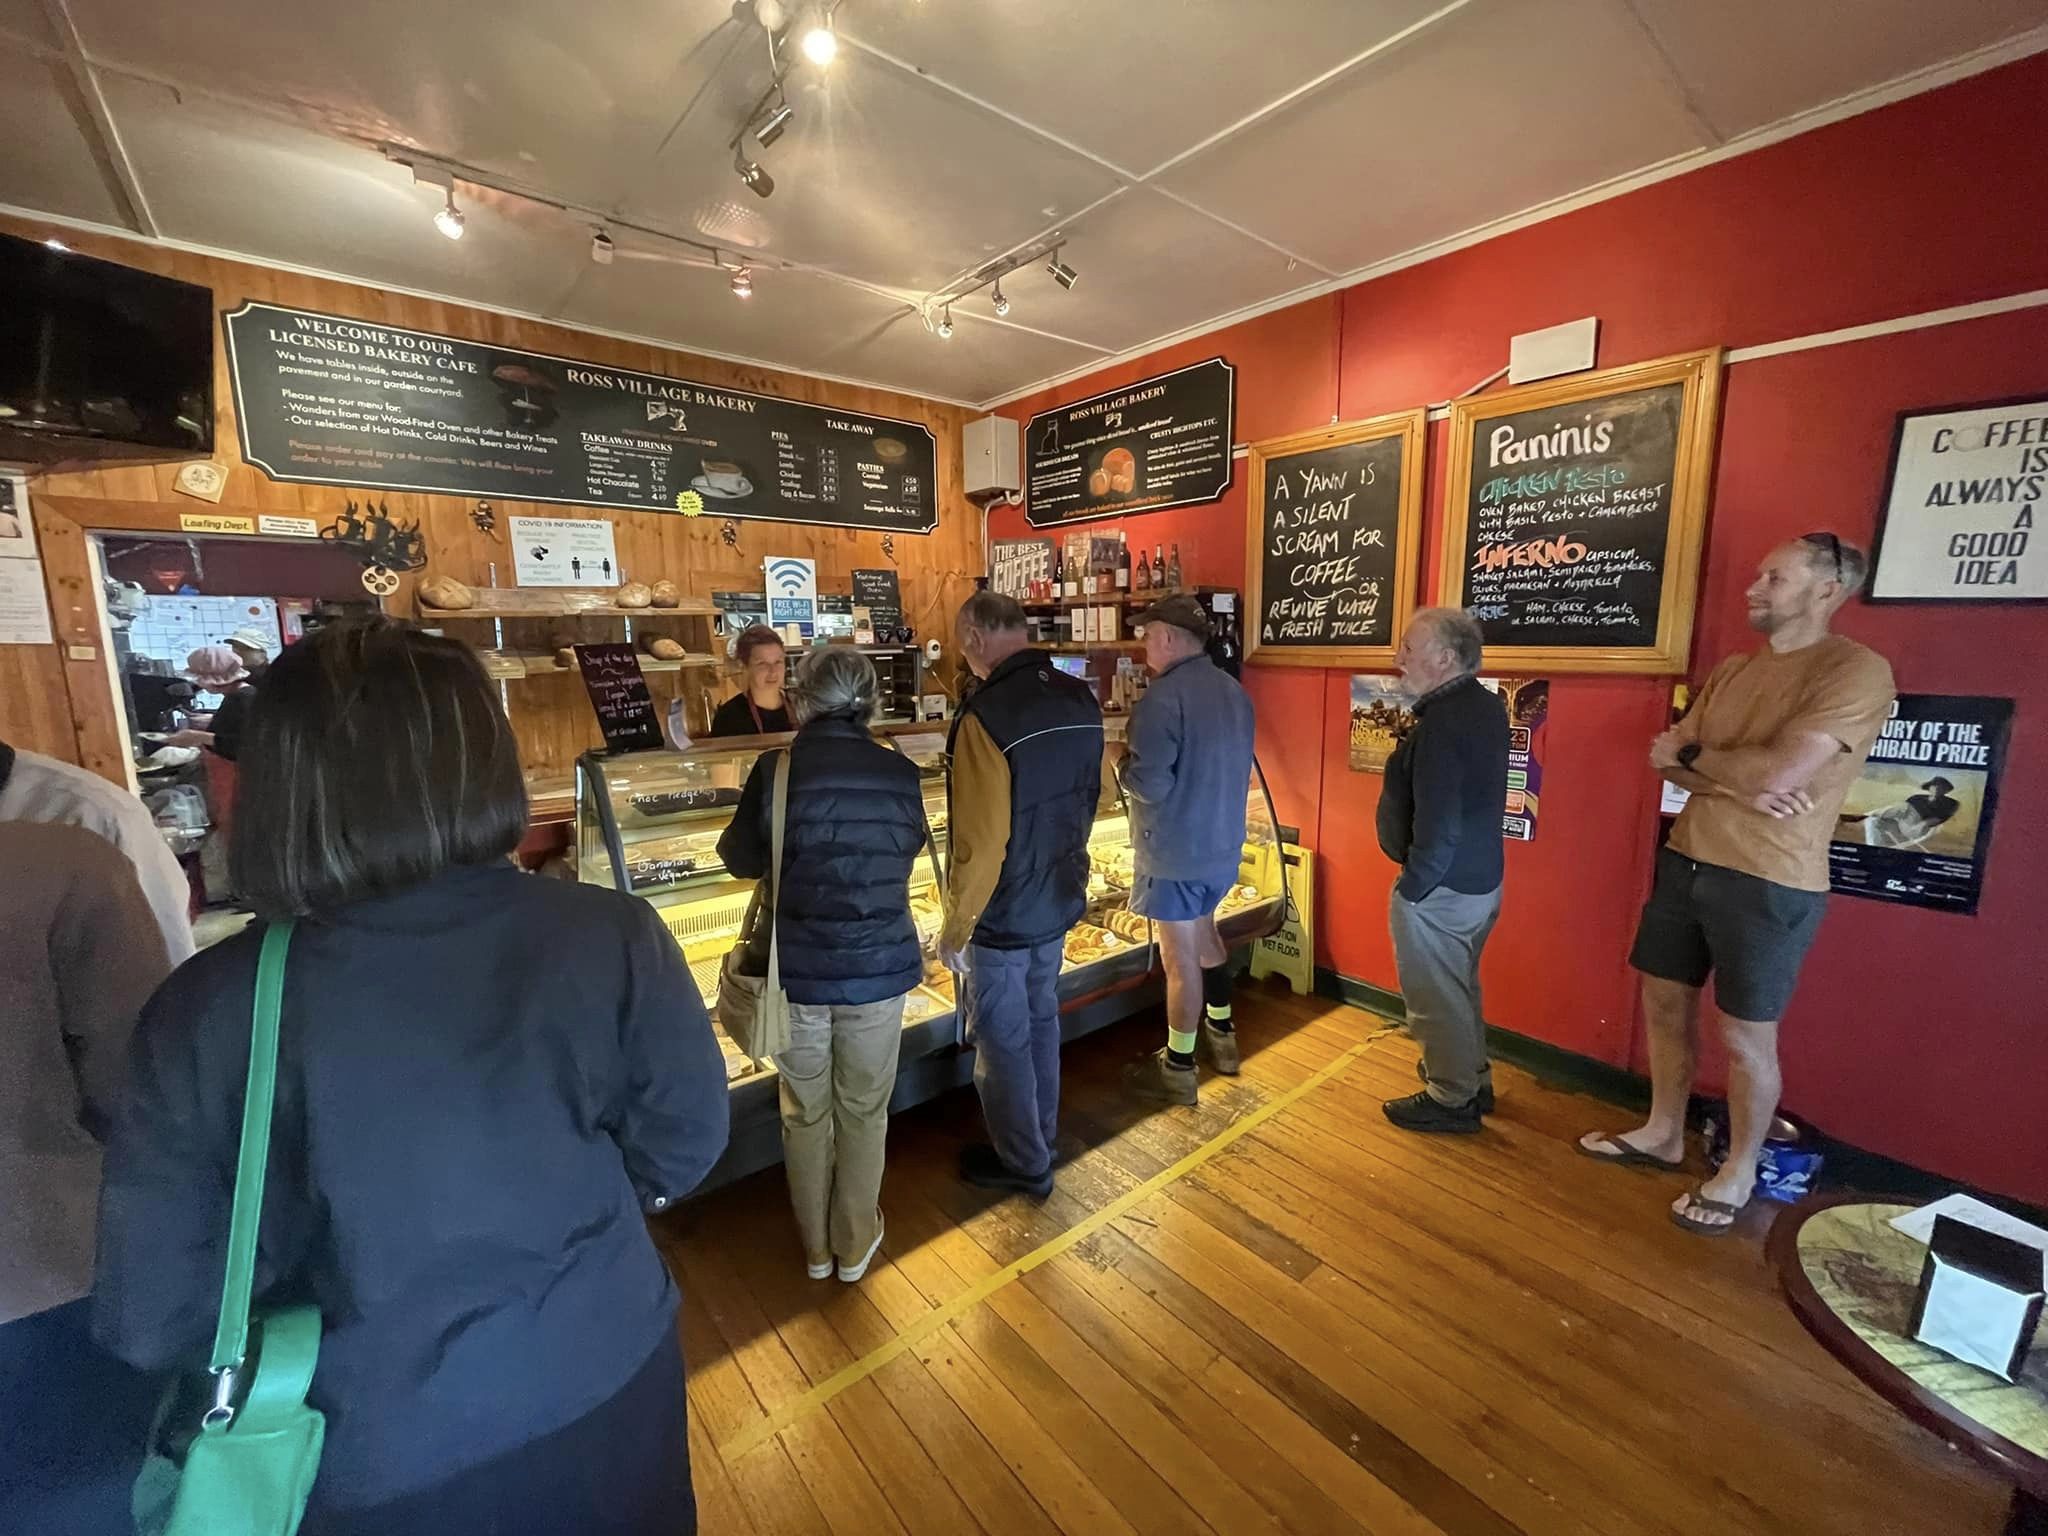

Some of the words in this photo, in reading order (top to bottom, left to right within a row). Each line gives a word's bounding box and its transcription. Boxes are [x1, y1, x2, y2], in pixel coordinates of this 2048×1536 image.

[294, 317, 389, 344] WELCOME
[391, 334, 416, 349] TO
[419, 339, 454, 356] OUR
[269, 329, 360, 354] LICENSED
[364, 344, 432, 366] BAKERY
[436, 357, 478, 374] CAFE
[275, 349, 296, 361] We
[298, 352, 324, 365] have
[326, 358, 357, 370] tables
[358, 362, 389, 376] inside,
[391, 369, 425, 380] outside
[440, 375, 454, 385] the
[278, 364, 329, 378] pavement
[330, 372, 351, 382] and
[353, 374, 363, 383] in
[364, 376, 381, 385] our
[383, 380, 417, 391] garden
[419, 385, 464, 398] courtyard.
[566, 368, 613, 389] ROSS
[616, 377, 692, 403] VILLAGE
[695, 391, 757, 414] BAKERY
[281, 388, 316, 402] Please
[318, 395, 335, 404] see
[338, 397, 355, 406] our
[357, 400, 383, 410] menu
[1069, 408, 1090, 422] ROSS
[1090, 396, 1128, 415] VILLAGE
[1129, 384, 1167, 405] BAKERY
[288, 401, 337, 416] Wonders
[338, 407, 361, 419] from
[362, 413, 379, 422] our
[436, 421, 461, 432] Oven
[463, 425, 481, 435] and
[482, 427, 503, 438] other
[505, 430, 534, 442] Bakery
[535, 433, 558, 445] Treats
[290, 415, 312, 426] Our
[314, 419, 358, 431] selection
[360, 423, 370, 433] of
[372, 424, 390, 435] Hot
[392, 427, 423, 440] Drinks,
[425, 431, 447, 442] Cold
[449, 434, 478, 446] Drinks,
[479, 437, 503, 449] Beers
[504, 441, 521, 451] and
[522, 443, 548, 454] Wines
[825, 419, 850, 432] TAKE
[850, 424, 875, 436] AWAY
[580, 432, 635, 447] TAKEAWAY
[636, 440, 673, 452] DRINKS
[583, 444, 610, 454] Coffee
[1489, 414, 1615, 468] Paninis
[2019, 447, 2048, 474] IS
[586, 476, 601, 485] Hot
[602, 477, 640, 489] Chocolate
[587, 486, 604, 496] Tea
[1274, 474, 1290, 499] A
[1299, 467, 1348, 498] YAWN
[1360, 462, 1375, 485] IS
[1925, 475, 2045, 508] ALWAYS
[1273, 510, 1286, 529] A
[1291, 493, 1356, 528] SILENT
[1479, 503, 1504, 517] OVEN
[1508, 500, 1546, 519] BAKED
[1552, 489, 1605, 509] CHICKEN
[1613, 483, 1666, 504] BREAST
[184, 518, 222, 530] Loafing
[223, 520, 250, 531] Dept.
[1479, 515, 1502, 529] WITH
[1505, 515, 1537, 529] BASIL
[2013, 503, 2033, 529] A
[1271, 530, 1339, 558] SCREAM
[1352, 527, 1385, 550] FOR
[1477, 529, 1516, 543] CHEESE
[1948, 531, 2028, 558] GOOD
[994, 544, 1016, 562] THE
[1018, 542, 1044, 556] BEST
[1470, 534, 1589, 573] INFERNO
[993, 548, 1050, 594] COFFEE
[1954, 560, 2017, 585] IDEA
[1358, 582, 1380, 597] OR
[773, 599, 792, 609] FREE
[774, 608, 794, 617] RIGHT
[794, 608, 811, 617] HERE
[1269, 597, 1329, 619] REVIVE
[1337, 598, 1379, 617] WITH
[1263, 623, 1274, 640] A
[1279, 619, 1323, 639] FRESH
[1330, 619, 1376, 639] JUICE
[1920, 721, 1944, 741] OF
[1947, 722, 1983, 744] THE
[1869, 738, 1933, 761] HIBALD
[1935, 742, 1990, 766] PRIZE
[1278, 942, 1300, 958] FLOOR
